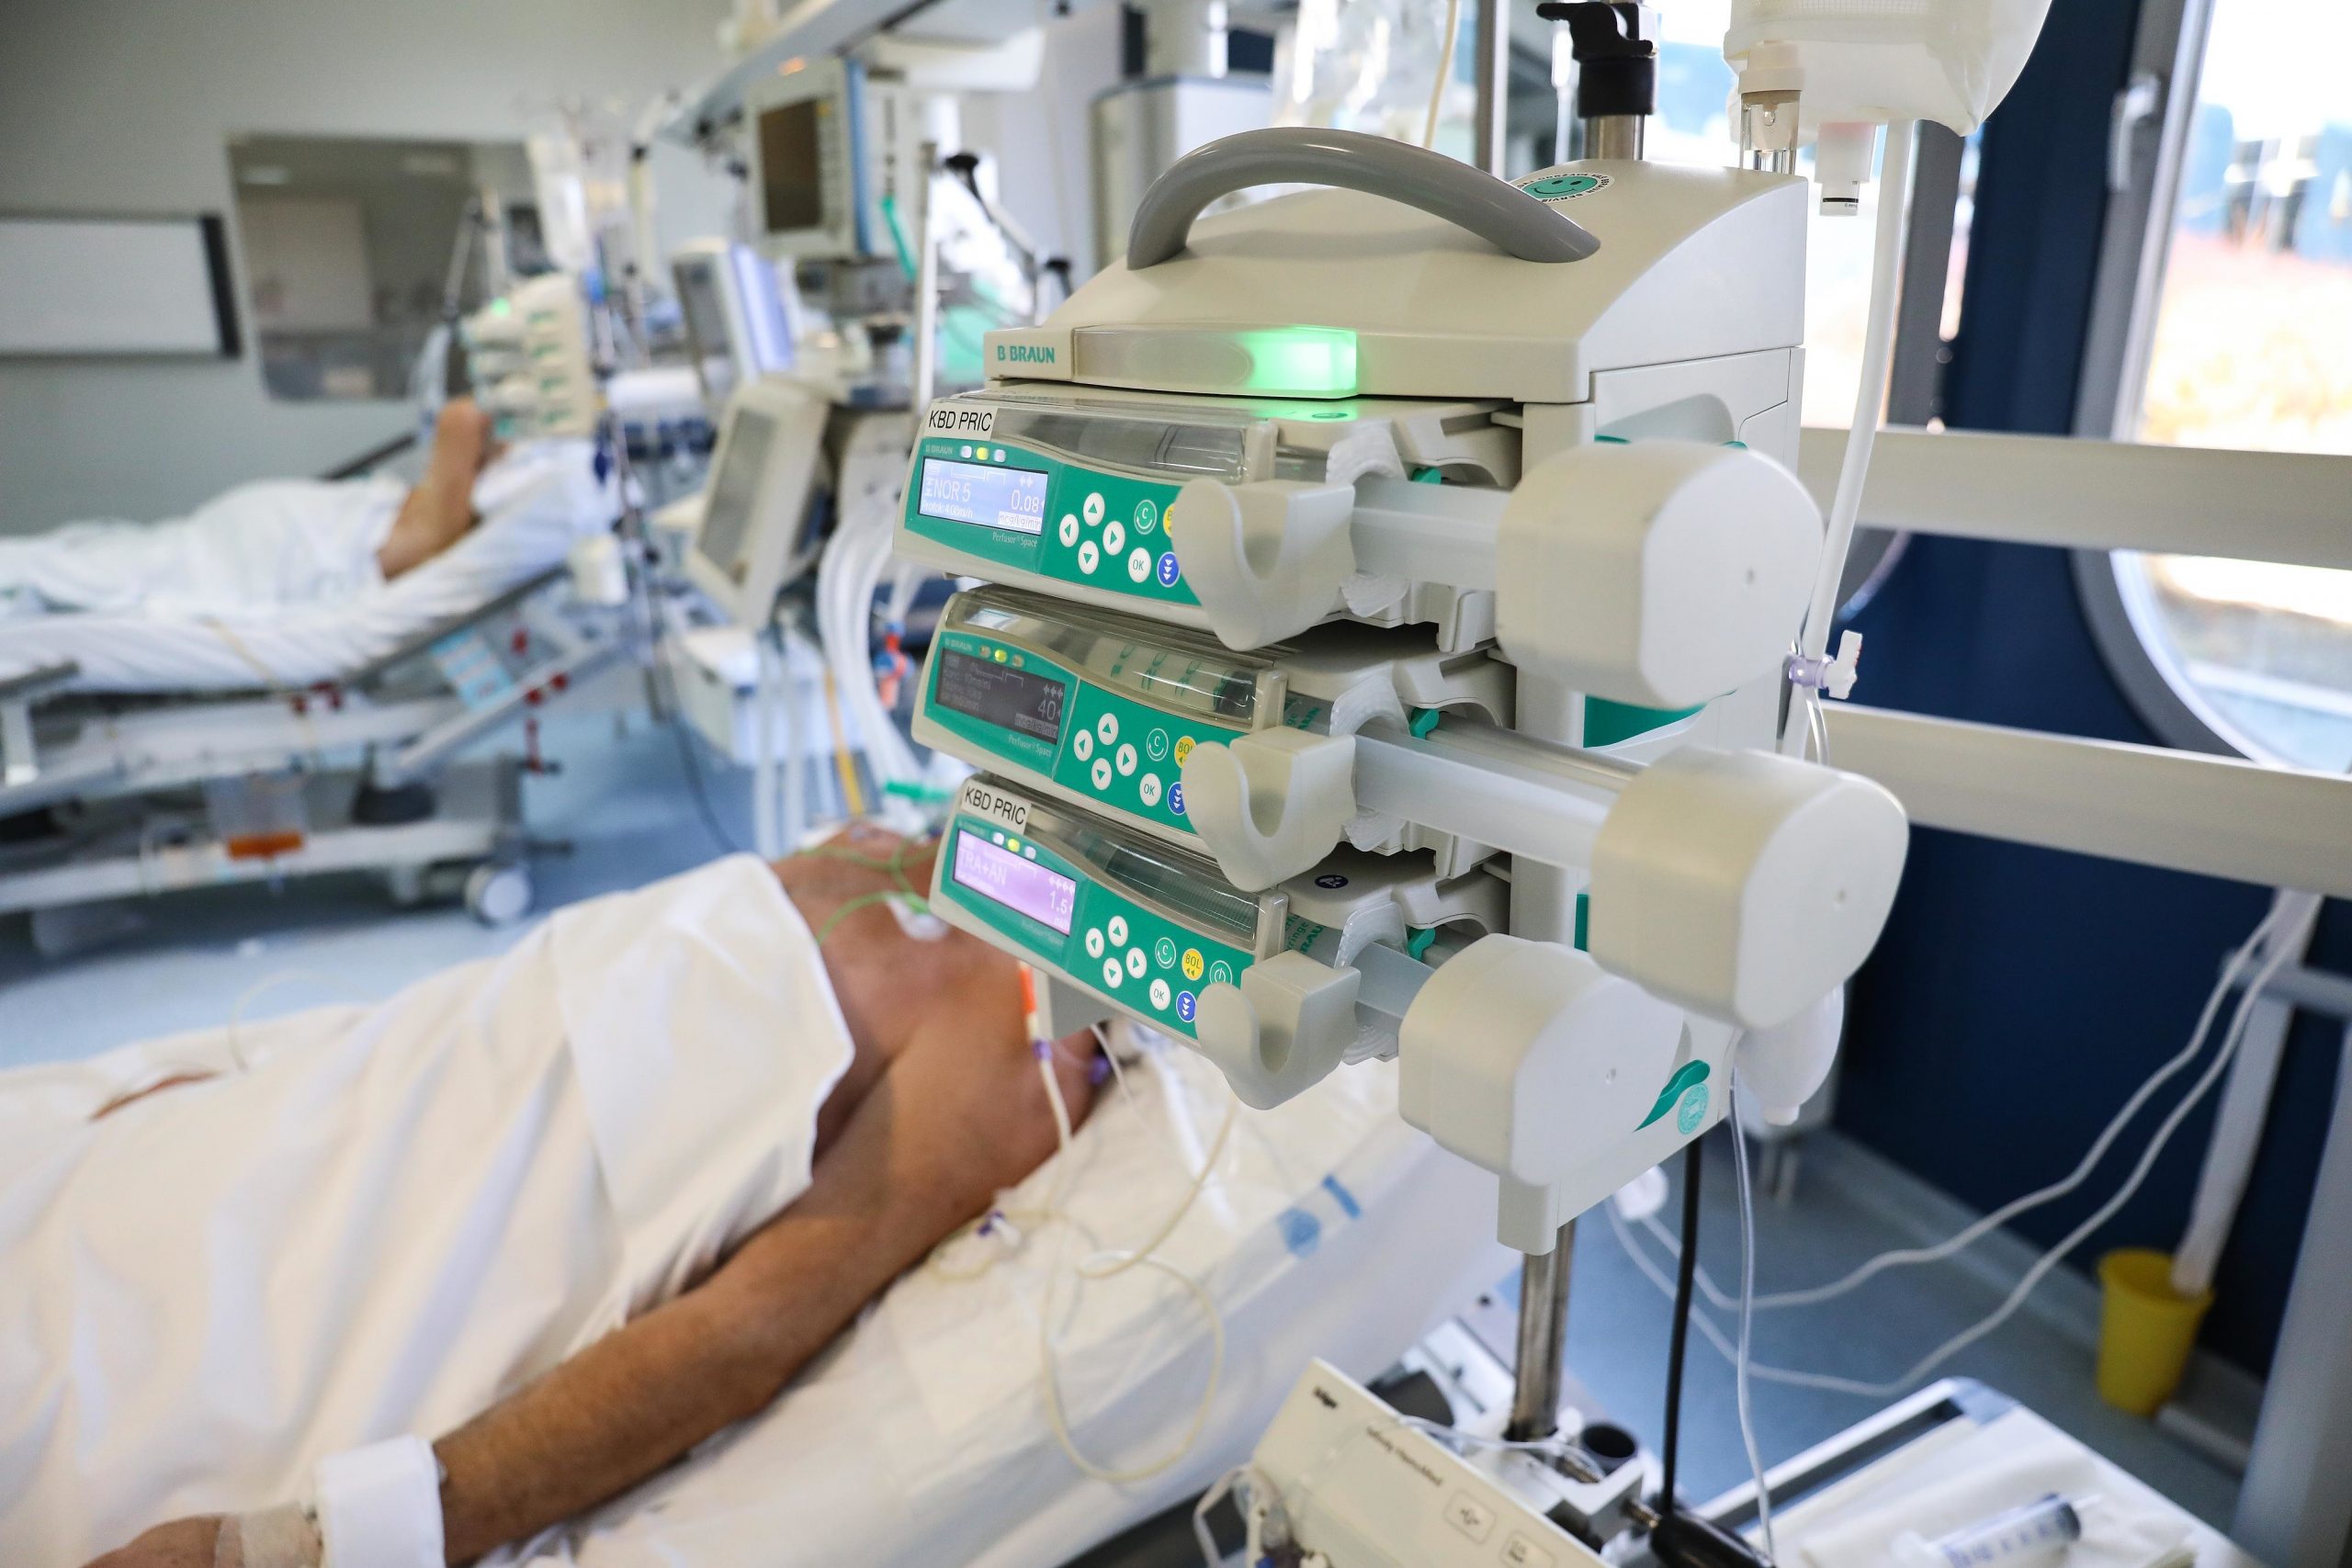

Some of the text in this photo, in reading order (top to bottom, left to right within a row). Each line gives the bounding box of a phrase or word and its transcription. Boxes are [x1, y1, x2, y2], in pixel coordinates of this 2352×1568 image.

[1010, 345, 1056, 364] BRAUN
[928, 410, 993, 433] KBD PRIC
[1011, 489, 1040, 513] 0.08
[1132, 558, 1145, 571] OK
[1038, 699, 1057, 721] 40
[1144, 784, 1156, 796] OK
[965, 787, 1026, 825] KBD PRIC
[1049, 890, 1068, 915] 1.5
[1185, 953, 1201, 969] BOL
[1153, 988, 1165, 1002] OK
